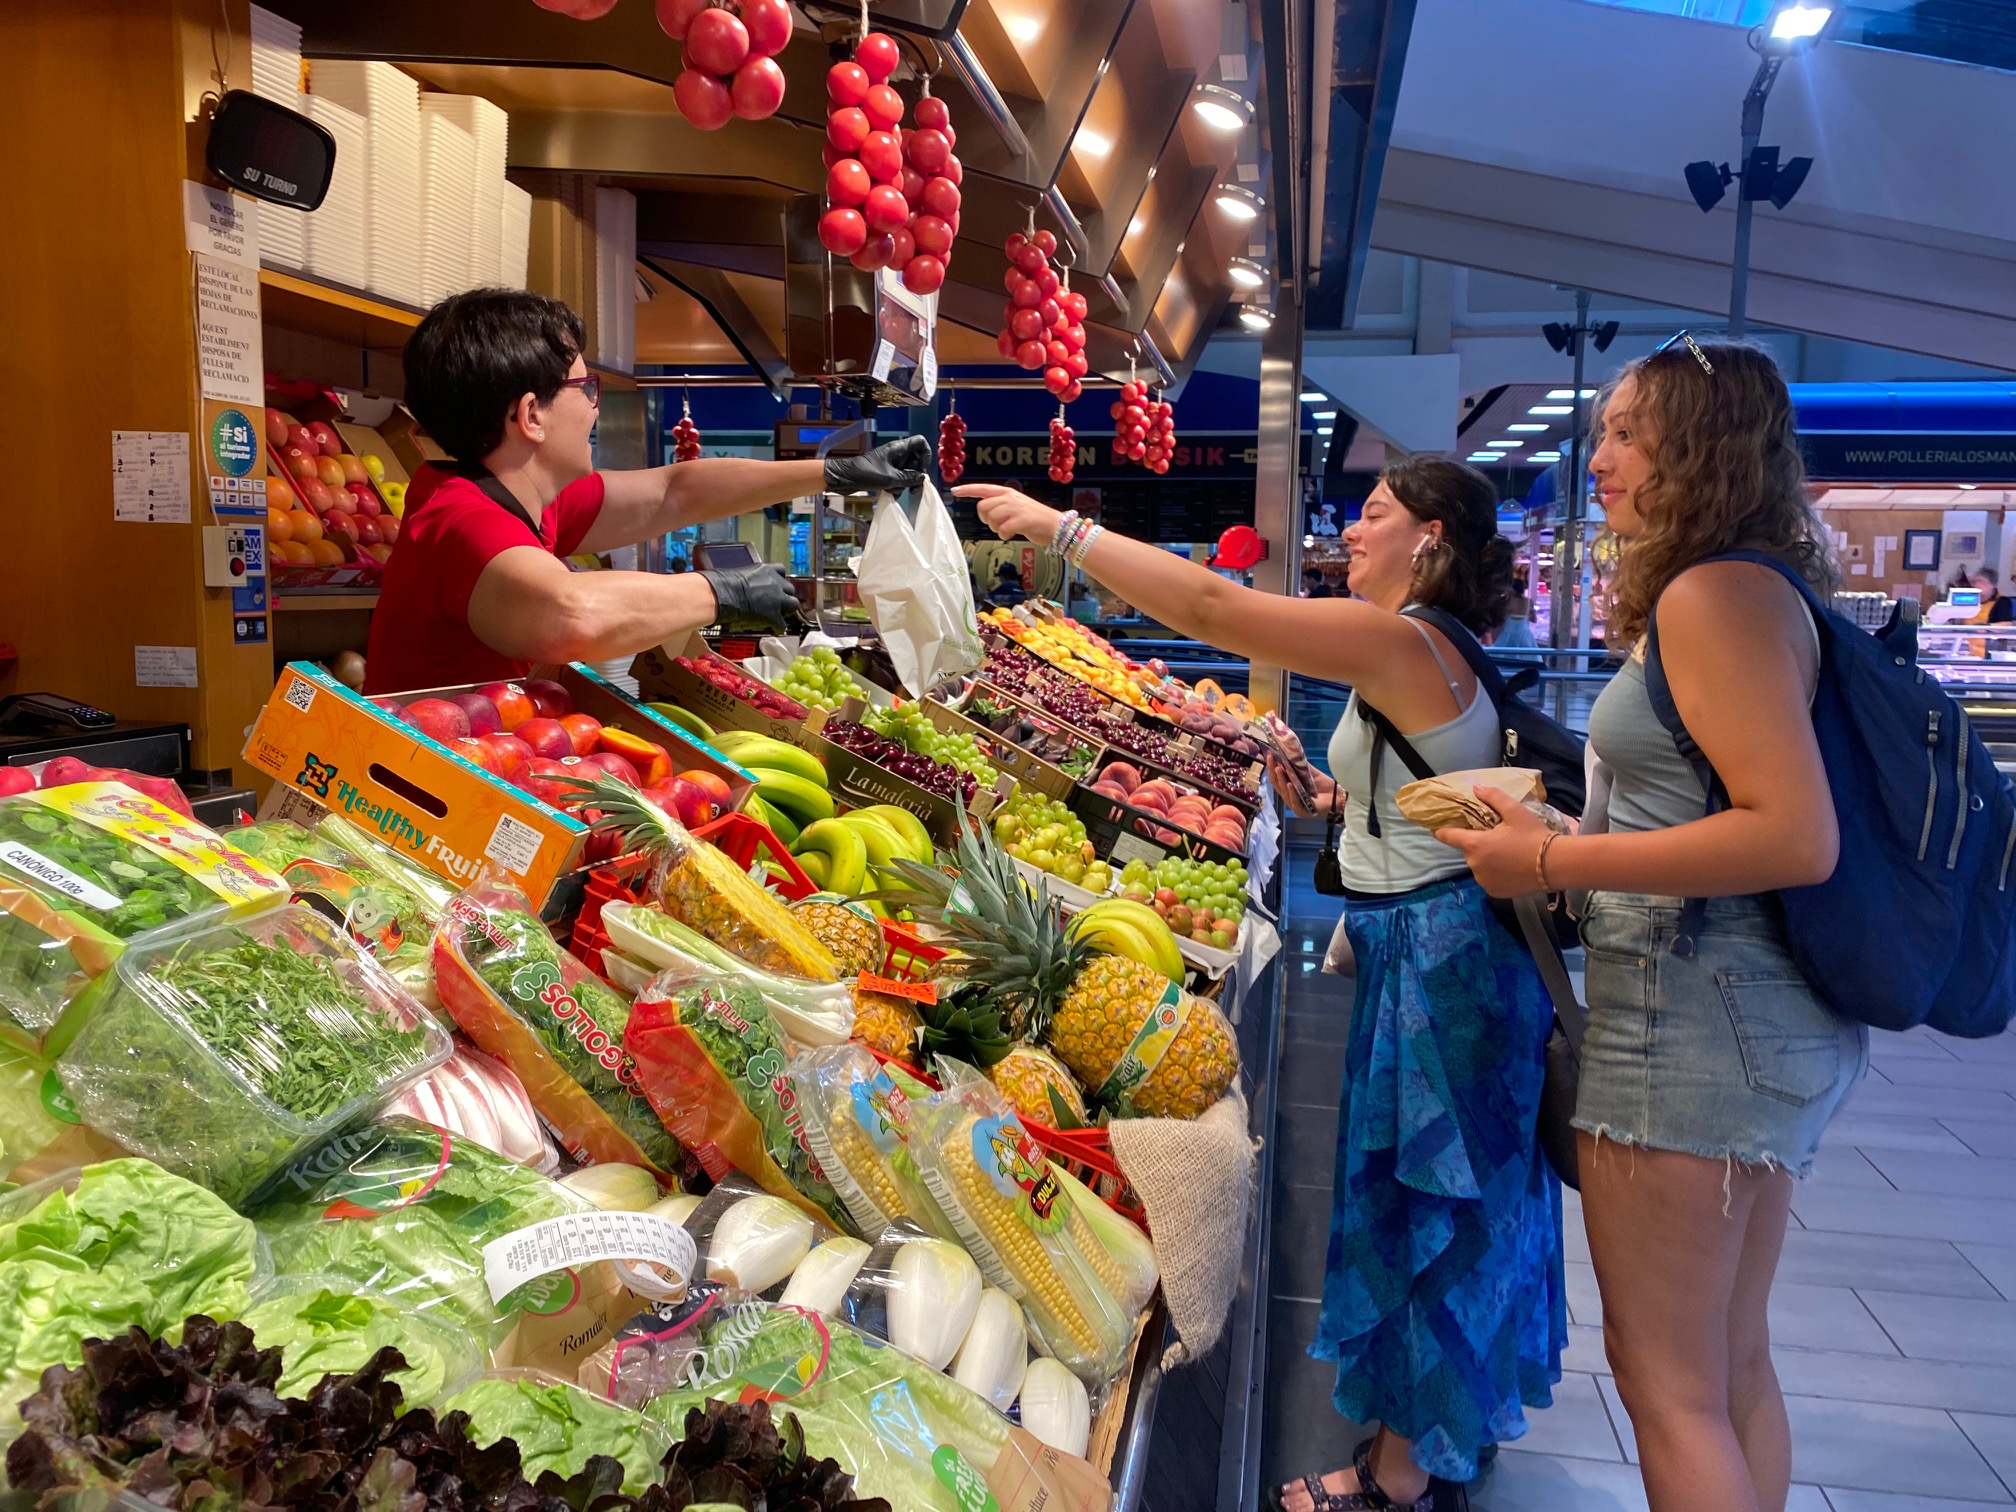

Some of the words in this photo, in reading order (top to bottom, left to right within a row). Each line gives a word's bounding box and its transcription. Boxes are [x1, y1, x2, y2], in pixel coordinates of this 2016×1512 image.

[243, 166, 261, 183] SU
[263, 173, 298, 196] TURNO
[210, 201, 222, 213] NO
[223, 205, 243, 220] TOCAR
[210, 214, 219, 224] EL
[208, 226, 223, 239] POR
[223, 231, 244, 245] FAVOR
[213, 241, 242, 256] GRACIAS
[199, 263, 216, 276] ESTE
[216, 269, 239, 282] LOCAL
[199, 275, 229, 291] DISPONE
[229, 284, 238, 293] DE
[239, 286, 253, 297] LAS
[200, 287, 222, 300] HOJAS
[223, 293, 232, 302] DE
[200, 298, 259, 320] RECLAMACIONES
[201, 322, 228, 336] AQUEST
[201, 334, 250, 351] ESTABLIMENT
[201, 345, 230, 359] DISPOSA
[231, 352, 242, 361] DE
[202, 357, 224, 369] FULLS
[225, 362, 235, 370] DE
[203, 368, 250, 384] RECLAMACIO
[219, 450, 251, 460] integrador
[226, 443, 250, 452] turismo
[976, 446, 1096, 466] KOREN
[1110, 446, 1224, 466] BSIK
[245, 537, 261, 550] AM
[698, 680, 737, 708] FRESA
[845, 766, 870, 790] La
[337, 779, 430, 850] Healthy
[6, 850, 63, 882] CANÓNIGO
[58, 879, 85, 895] 100g
[511, 961, 562, 1000] 3
[746, 1047, 786, 1089] 3
[1124, 1055, 1136, 1077] air
